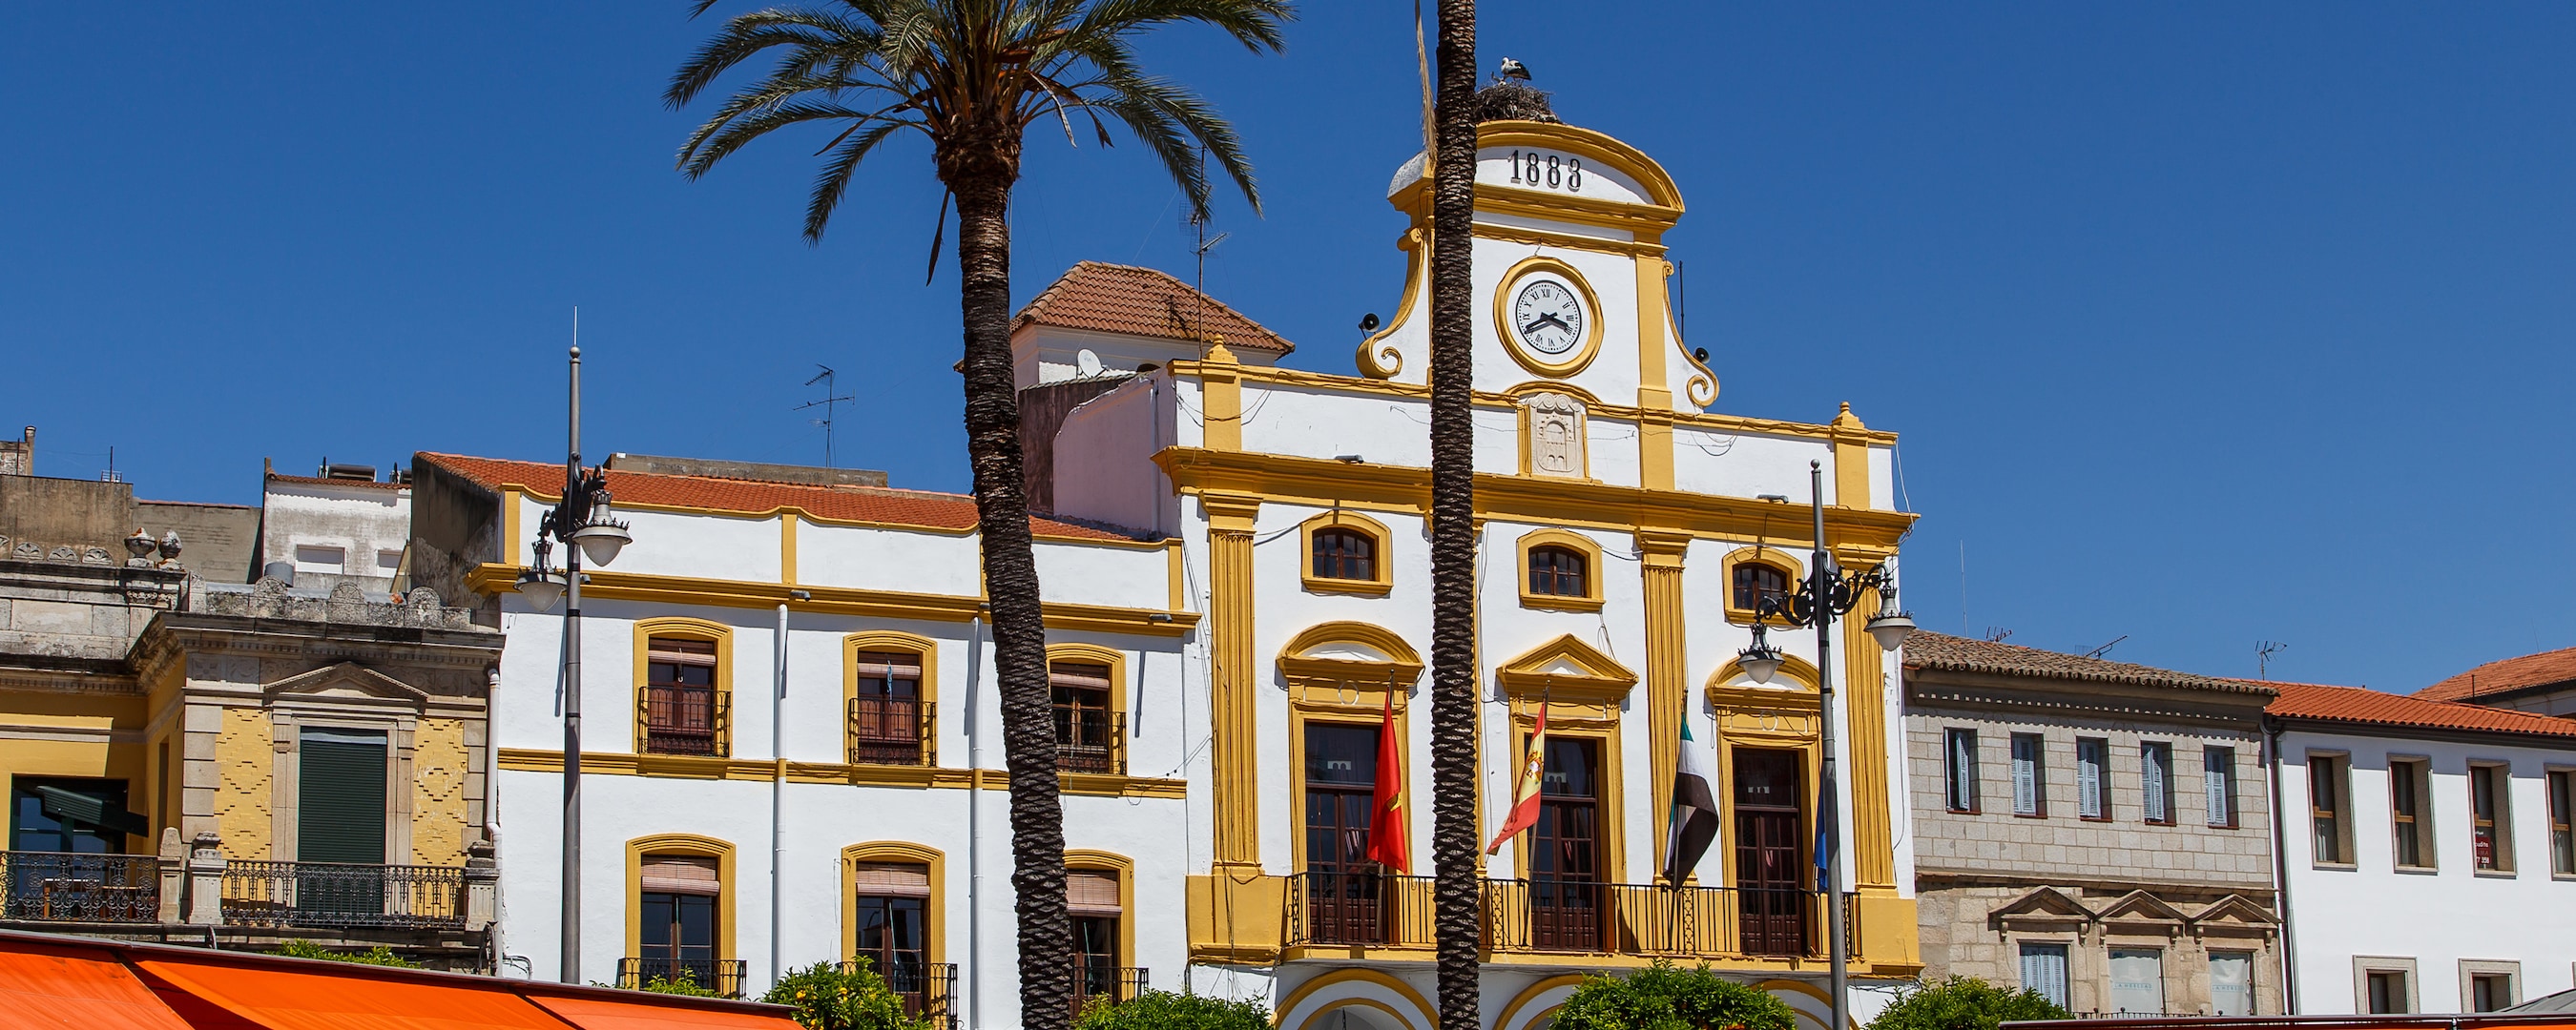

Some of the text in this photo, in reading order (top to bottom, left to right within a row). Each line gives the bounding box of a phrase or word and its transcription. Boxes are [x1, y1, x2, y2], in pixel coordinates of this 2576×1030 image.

[1507, 149, 1582, 193] 1883
[1530, 291, 1540, 301] XI
[1540, 288, 1550, 299] XII
[1561, 301, 1570, 310] II
